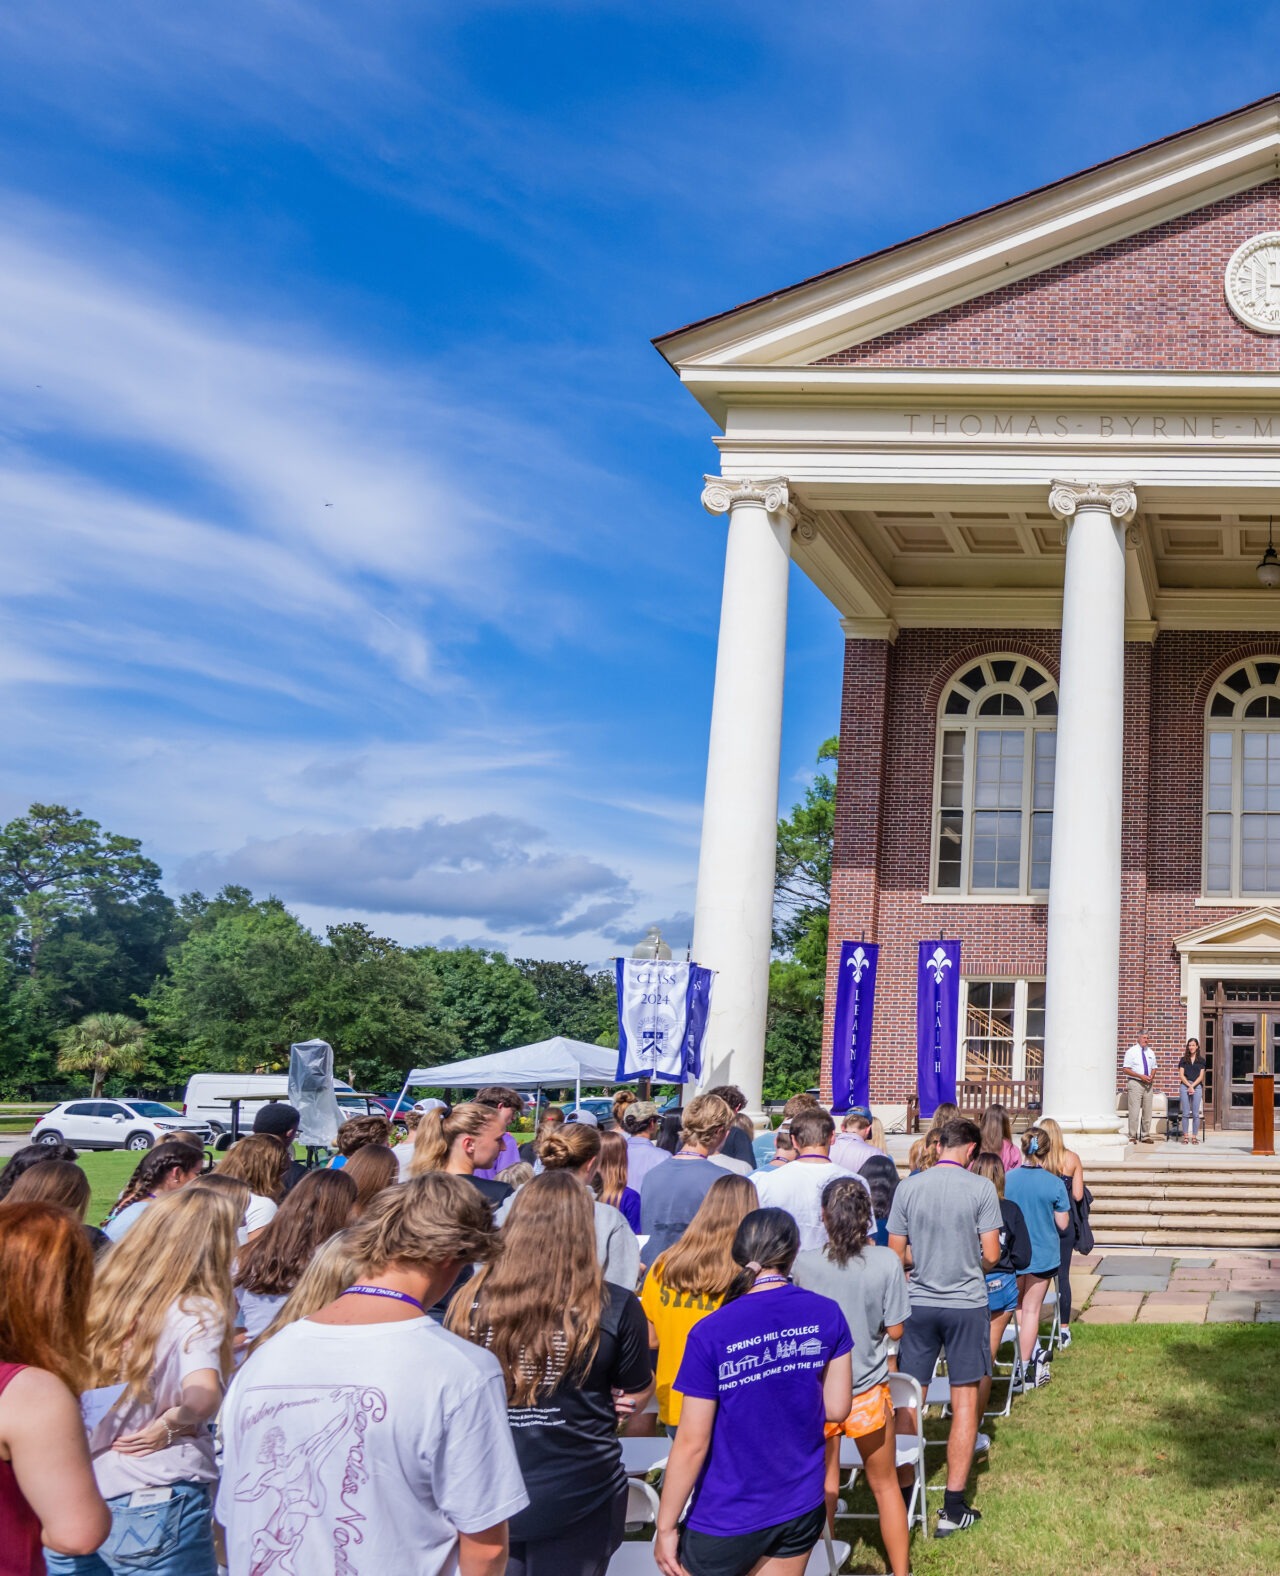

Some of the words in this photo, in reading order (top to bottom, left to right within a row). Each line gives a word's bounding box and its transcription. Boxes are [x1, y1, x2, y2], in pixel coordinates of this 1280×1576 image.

[903, 413, 1070, 438] THOMAS
[1099, 415, 1226, 440] BYRNE
[640, 994, 670, 1005] 2024
[848, 989, 860, 1106] LEARNNG
[934, 1000, 942, 1073] FAITH
[659, 1283, 718, 1311] STAF
[726, 1336, 762, 1354] SPRING
[763, 1331, 779, 1342] HILL
[780, 1324, 820, 1338] COLLEGE
[718, 1381, 738, 1392] FIND
[739, 1372, 761, 1386] YOUR
[782, 1363, 796, 1372] ON
[797, 1360, 811, 1370] THE
[812, 1359, 825, 1369] HILL
